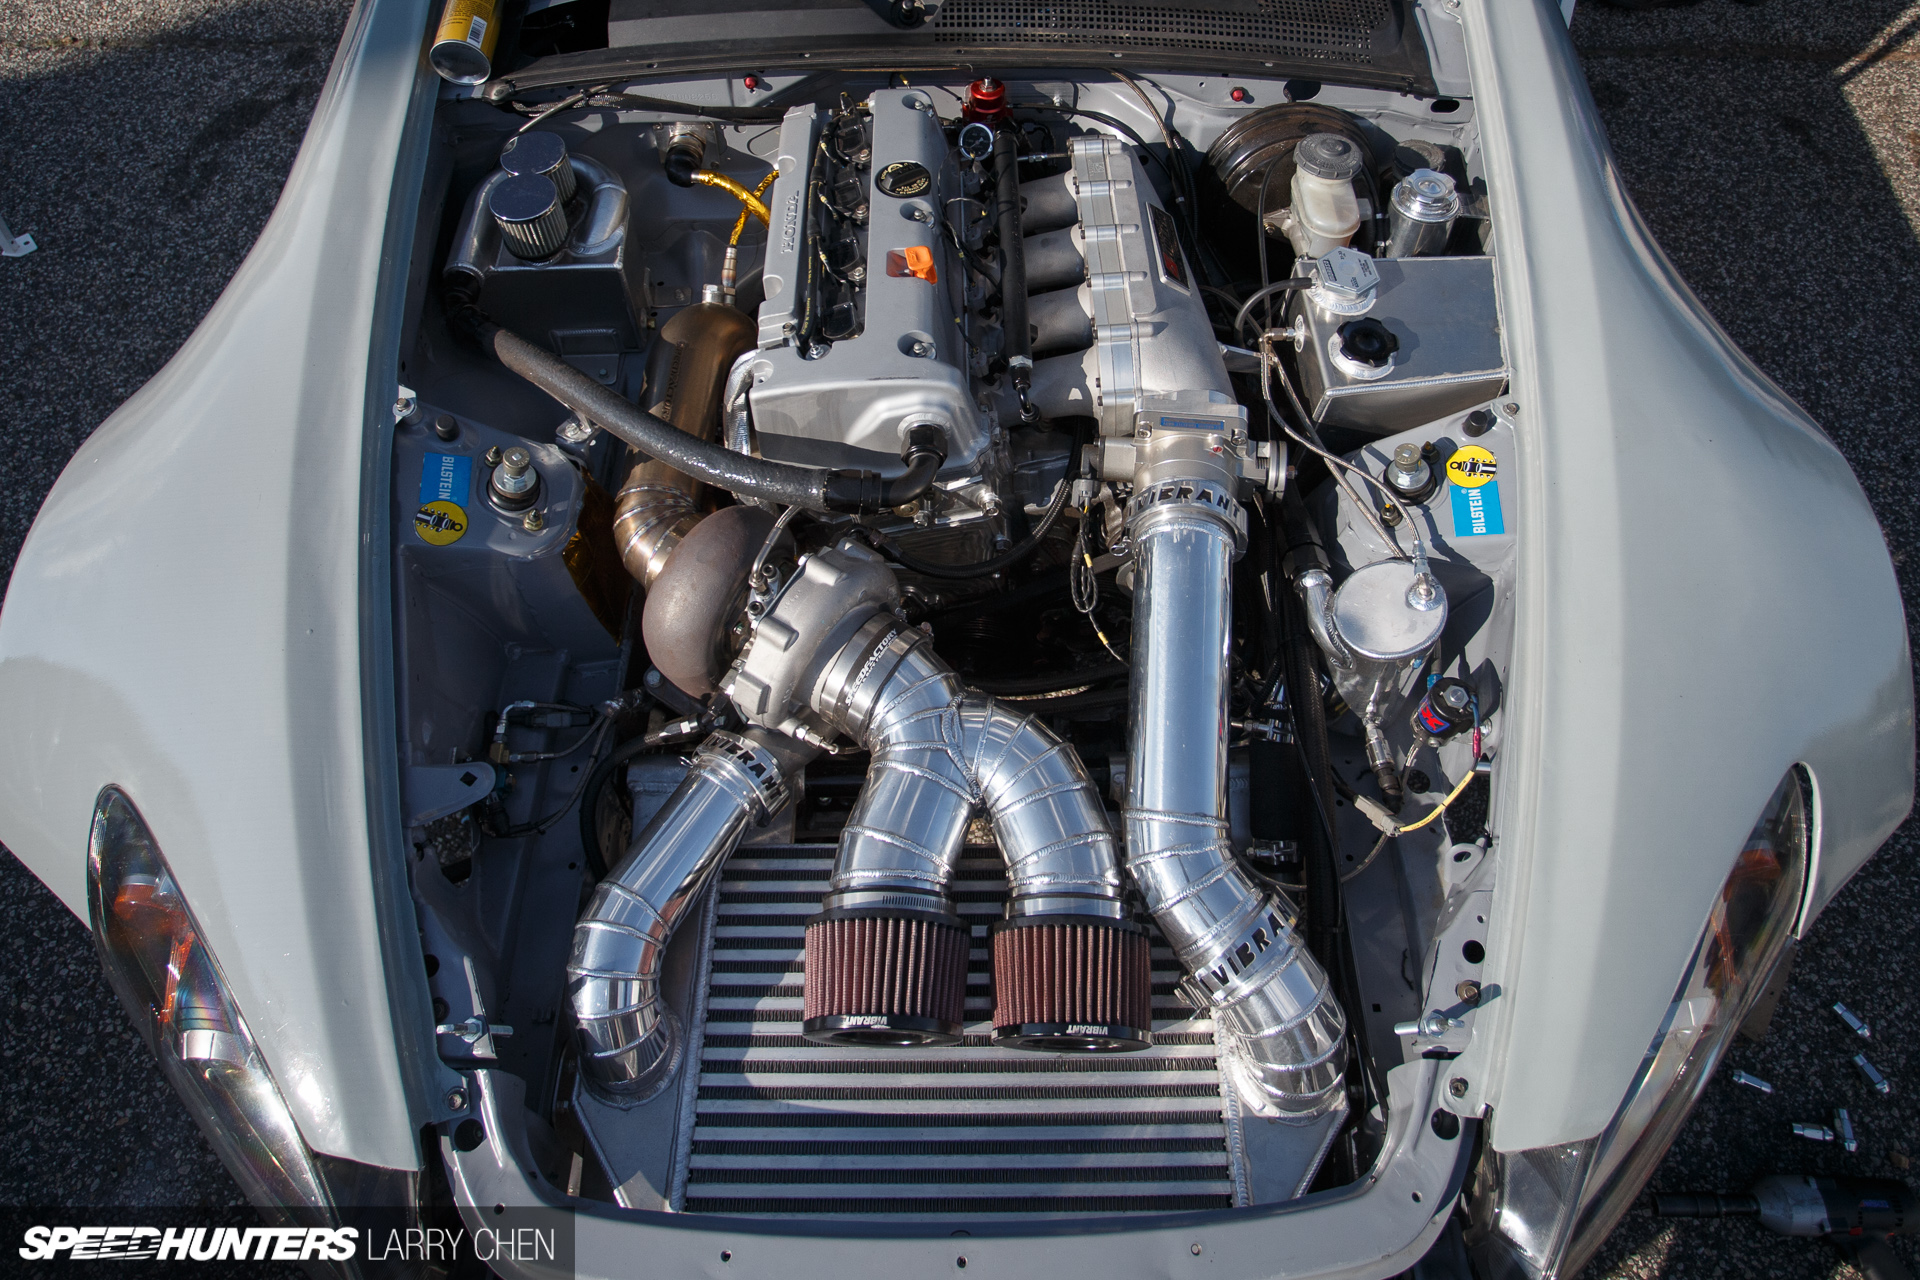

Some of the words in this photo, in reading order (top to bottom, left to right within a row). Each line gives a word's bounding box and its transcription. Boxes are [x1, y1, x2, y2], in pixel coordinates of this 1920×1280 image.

[781, 190, 800, 254] HONDA
[438, 456, 454, 499] BILSTEIN
[1137, 485, 1240, 519] VIBRANT
[1468, 488, 1486, 534] BILSTEIN
[845, 628, 897, 706] SPEEDFACTORY
[1211, 899, 1292, 987] VIBRAN
[843, 1015, 888, 1026] VIBRANT
[1065, 1024, 1108, 1036] VIBRANT
